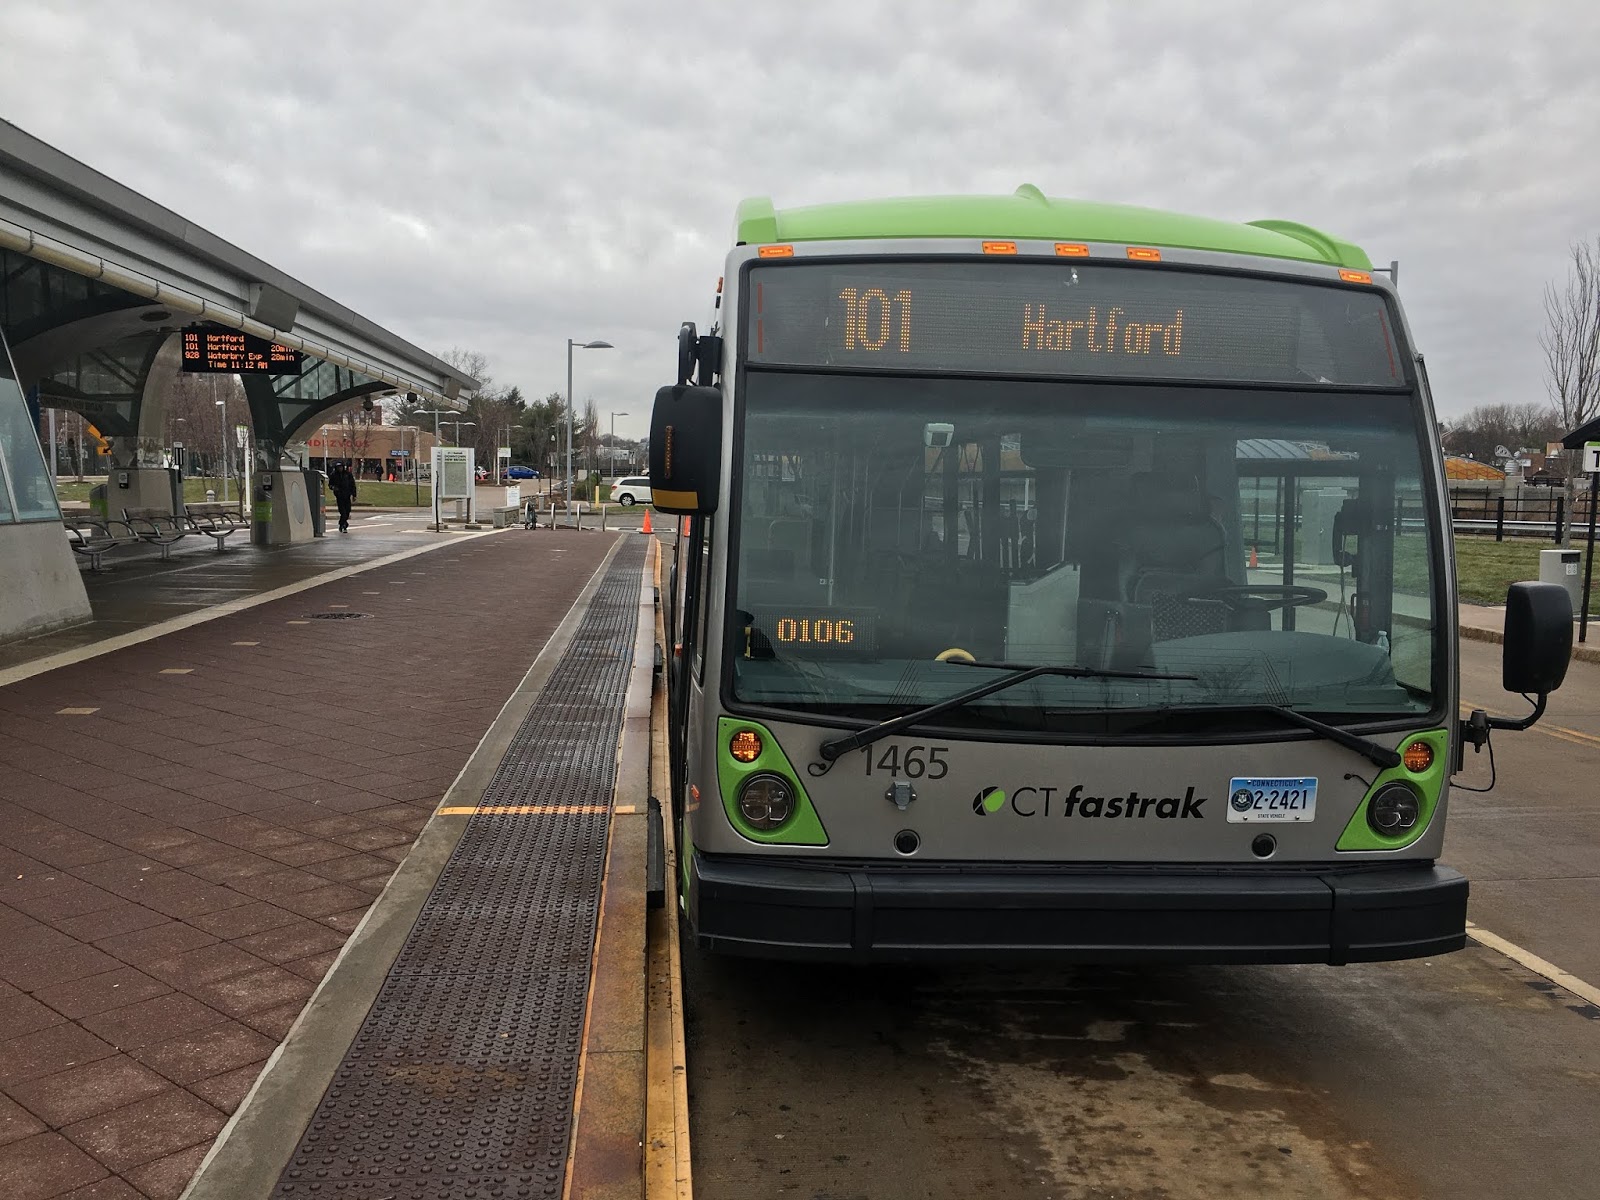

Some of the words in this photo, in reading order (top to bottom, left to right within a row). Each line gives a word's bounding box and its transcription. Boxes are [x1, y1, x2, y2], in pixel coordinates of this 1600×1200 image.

[839, 288, 911, 352] 101
[1022, 303, 1183, 355] Hartford
[185, 334, 198, 342] 101
[207, 334, 244, 342] Hartford
[185, 343, 199, 351] 101
[207, 343, 245, 351] Hartford
[185, 351, 200, 359] 928
[248, 353, 263, 361] Exp
[208, 361, 227, 369] Time
[231, 361, 255, 370] 11:12
[257, 362, 268, 370] AM
[777, 618, 854, 643] 0106
[860, 745, 949, 780] 1465
[1011, 786, 1057, 817] CT
[1063, 784, 1208, 819] fastrak
